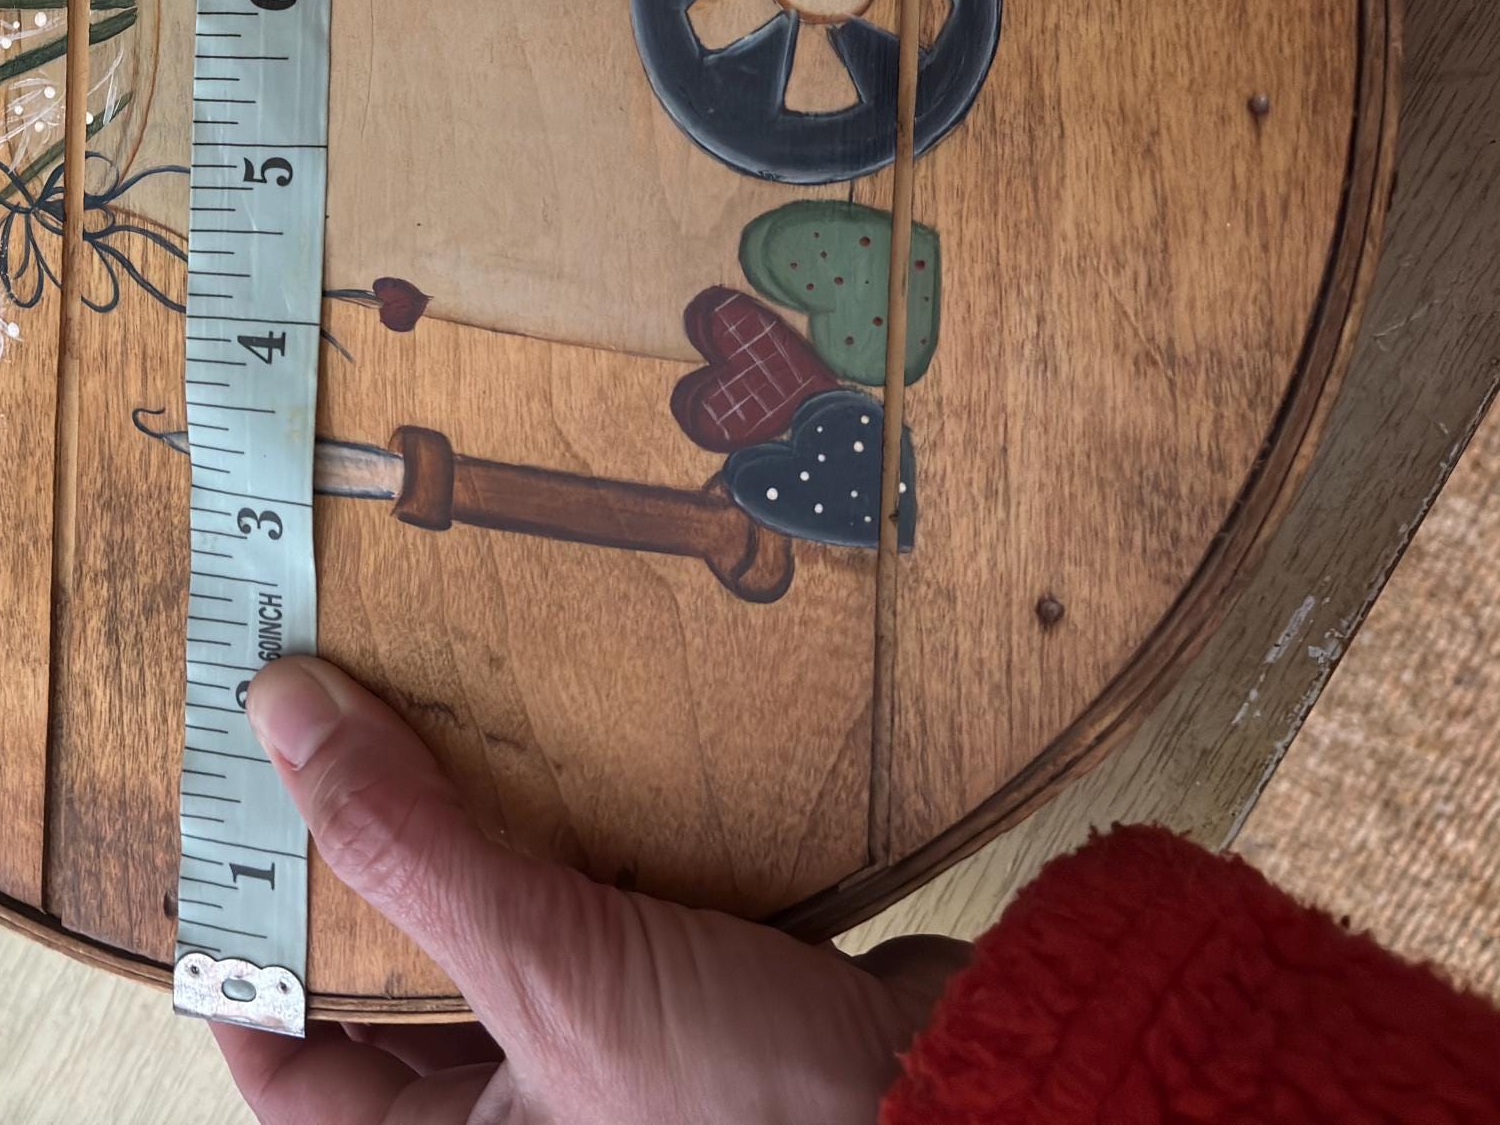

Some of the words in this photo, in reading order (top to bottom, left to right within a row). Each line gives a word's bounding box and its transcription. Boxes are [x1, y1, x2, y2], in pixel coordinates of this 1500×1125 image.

[243, 157, 293, 187] 5
[237, 331, 287, 365] 4
[237, 507, 284, 541] 3
[257, 592, 283, 662] 60INCH
[229, 862, 275, 891] 1
